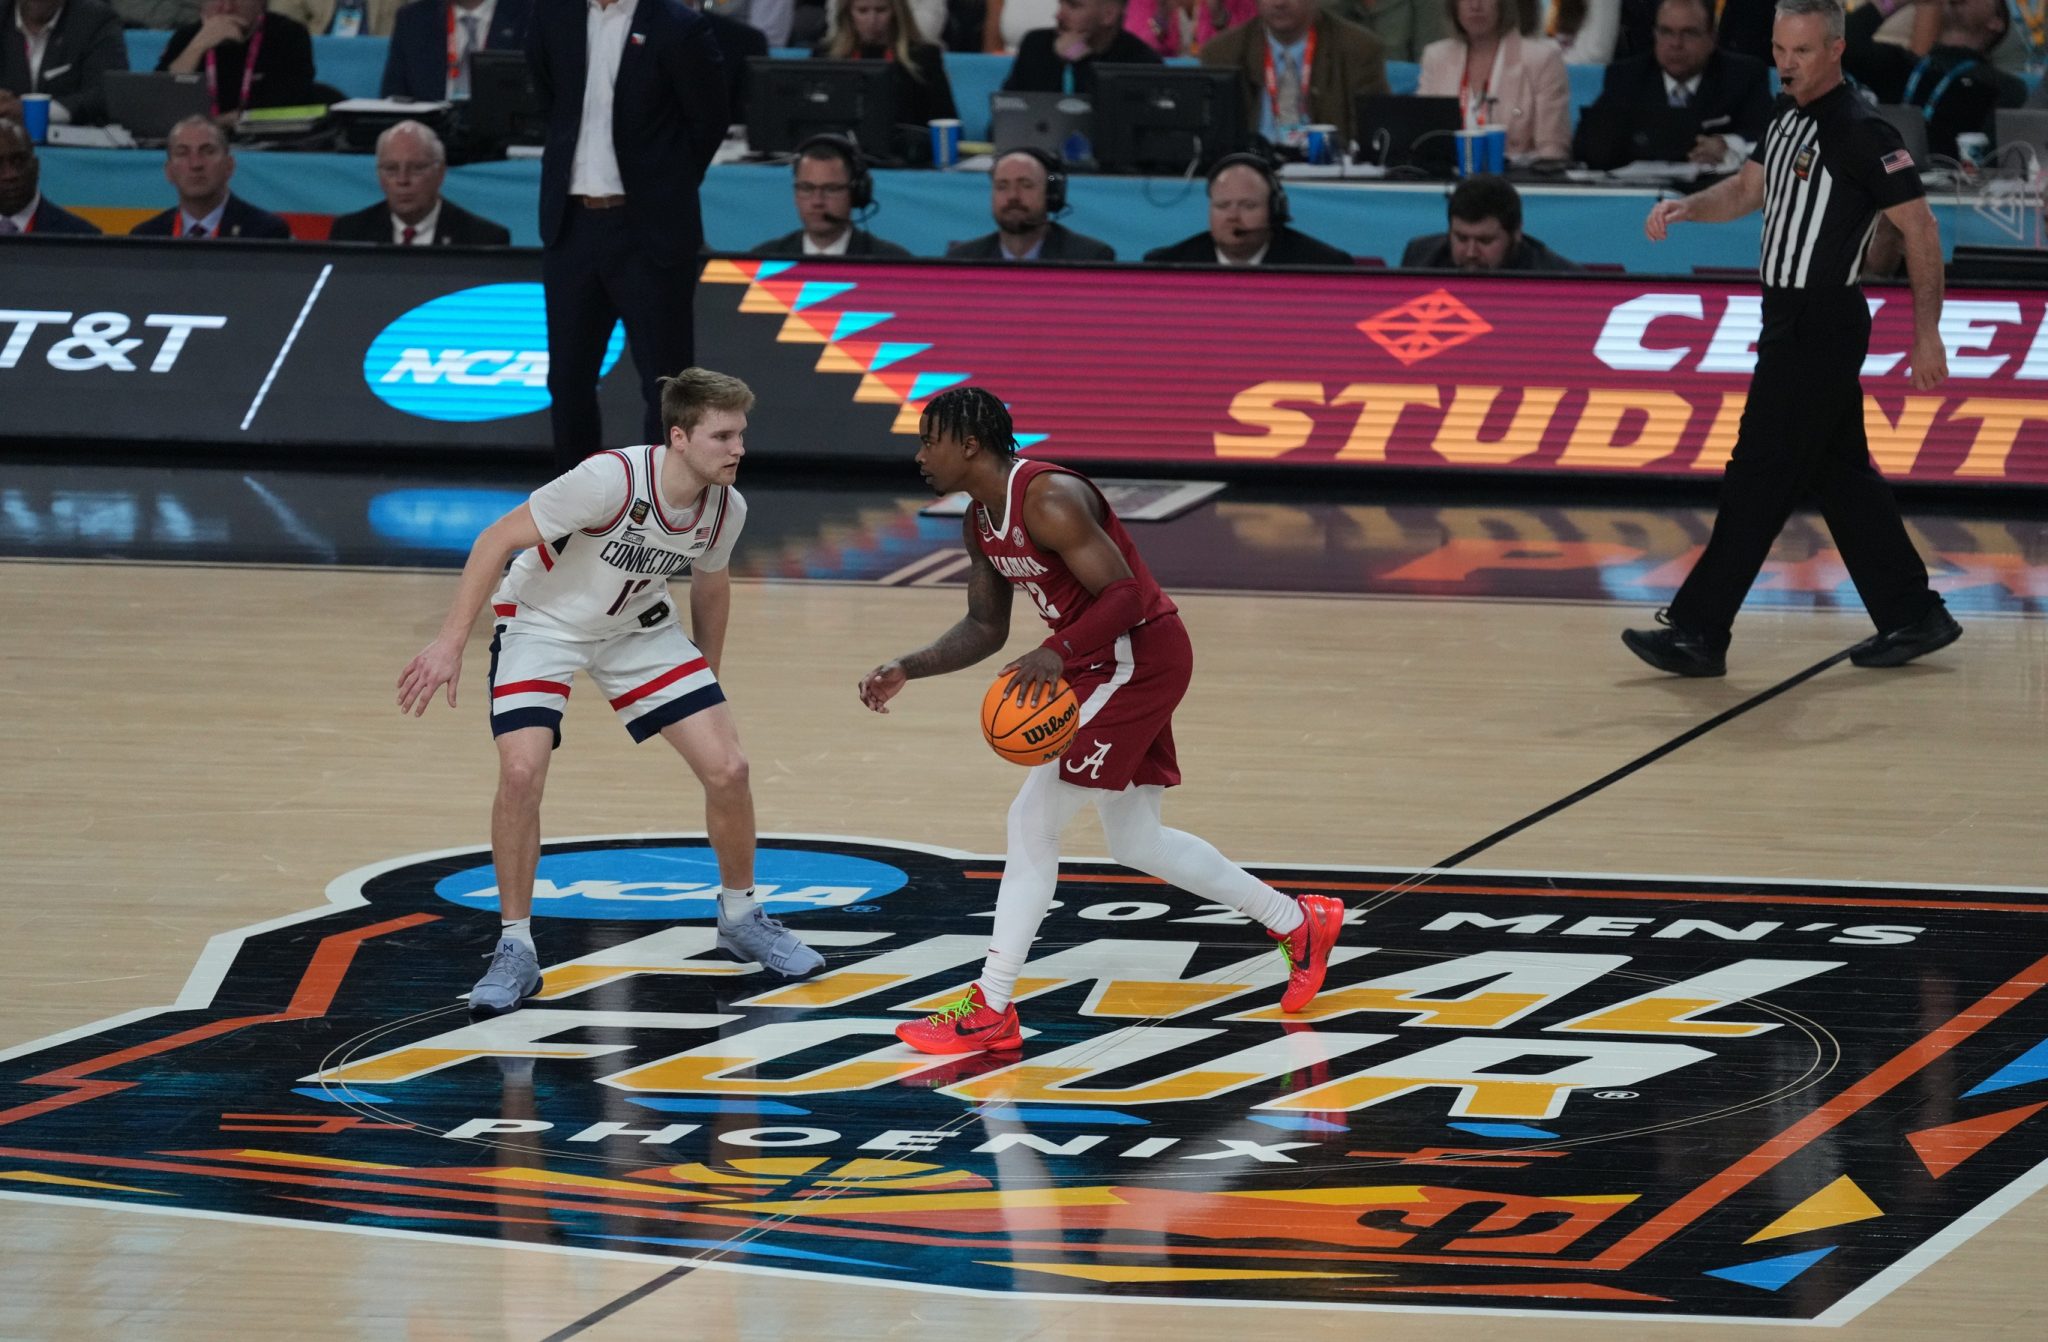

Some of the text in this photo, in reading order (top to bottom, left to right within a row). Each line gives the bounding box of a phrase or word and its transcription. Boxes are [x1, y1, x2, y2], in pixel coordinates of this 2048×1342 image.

[380, 348, 550, 388] NCA
[1021, 702, 1077, 745] Wilson
[1420, 911, 1926, 946] MEN'S
[456, 925, 1849, 1038] FINAL
[441, 1117, 1322, 1164] PHOENIX
